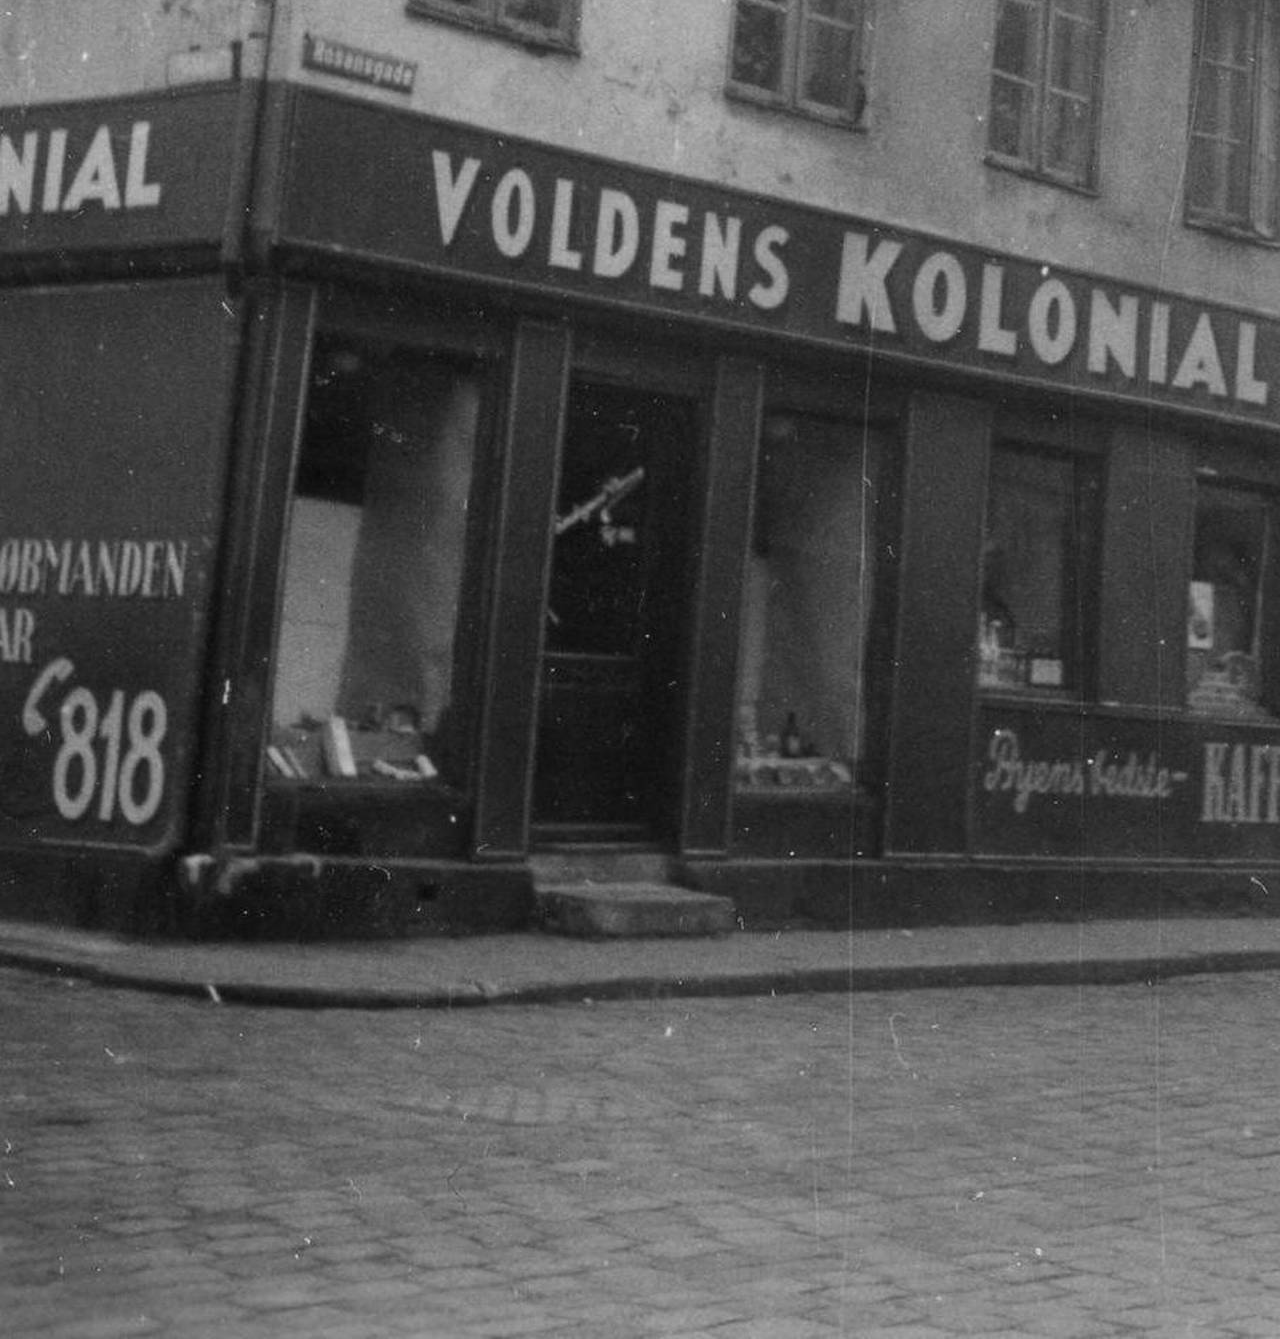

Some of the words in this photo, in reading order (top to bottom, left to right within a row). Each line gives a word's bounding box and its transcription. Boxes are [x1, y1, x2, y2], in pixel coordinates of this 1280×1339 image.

[0, 120, 162, 217] NIAL
[432, 150, 790, 310] VOLDENS
[835, 232, 1269, 405] KOLONIAL
[53, 685, 168, 825] 818
